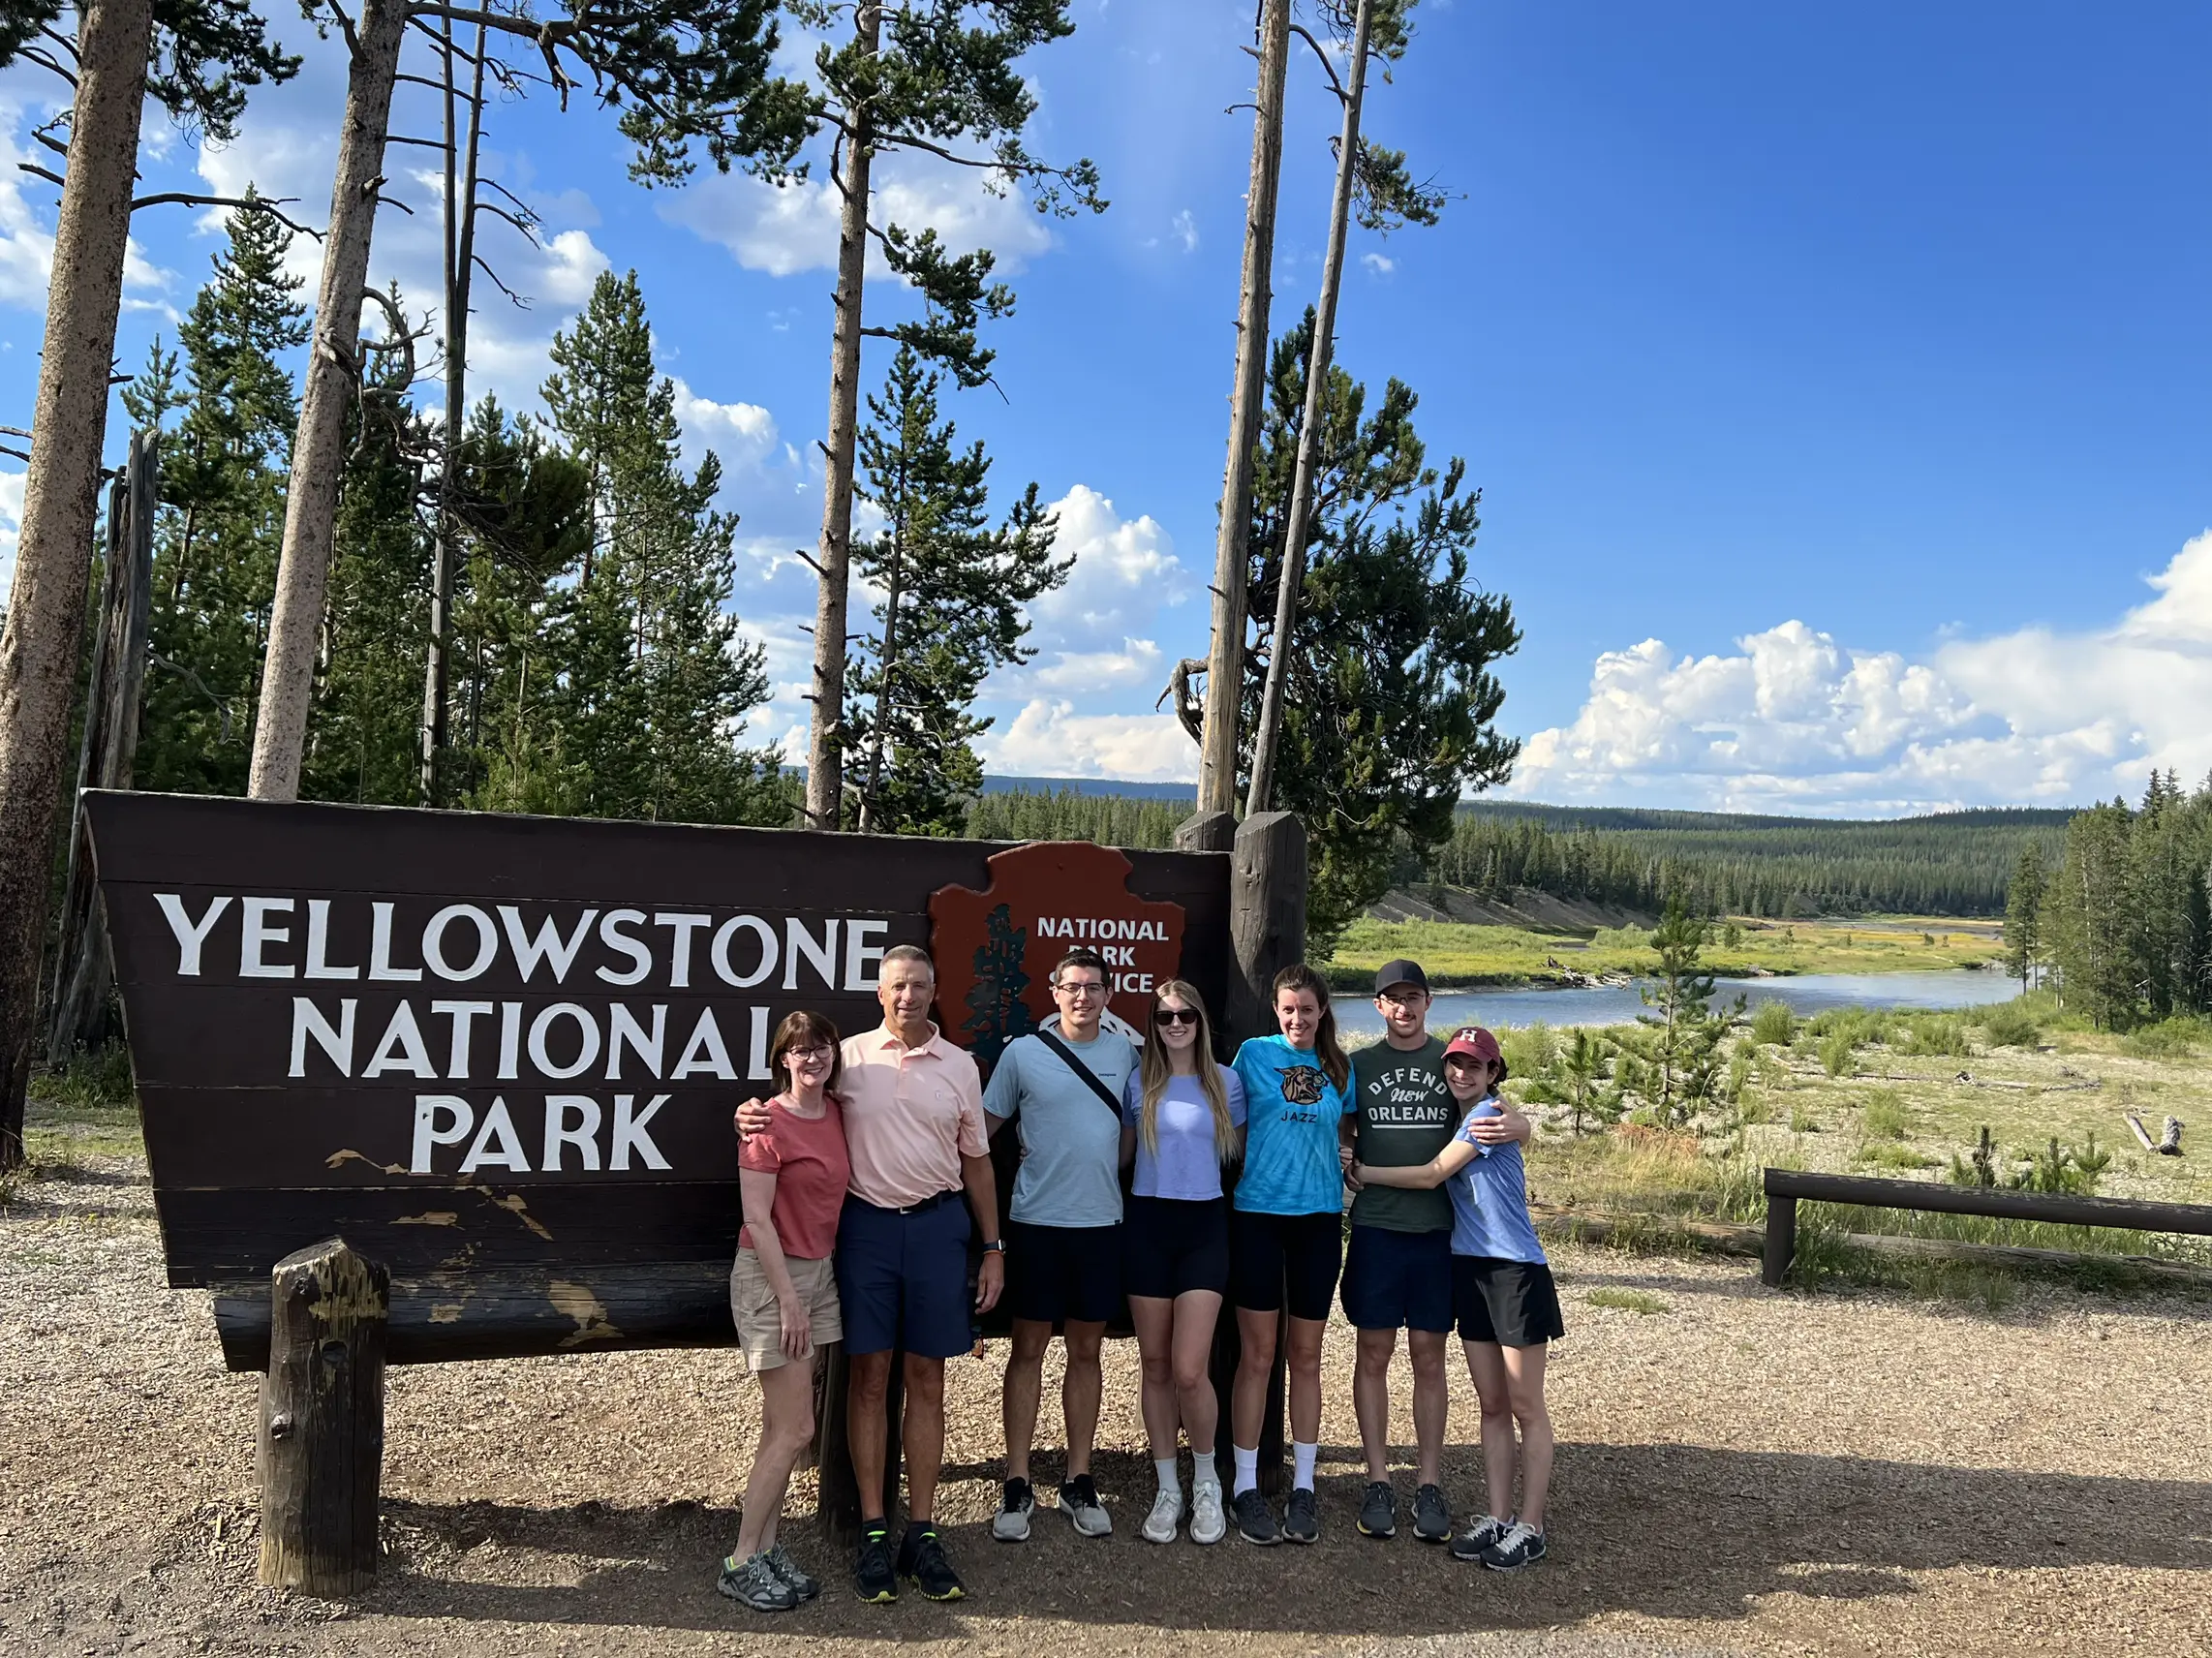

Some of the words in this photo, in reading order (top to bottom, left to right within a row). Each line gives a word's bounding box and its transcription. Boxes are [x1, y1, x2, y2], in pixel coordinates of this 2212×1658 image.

[1037, 916, 1170, 941] NATIONAL
[152, 893, 889, 992] YELLOWSTONE
[287, 997, 774, 1081] NATIONAL
[1459, 1029, 1478, 1043] H
[1367, 1067, 1448, 1095] DEFEND
[1280, 1110, 1318, 1123] JAZZ
[1367, 1106, 1449, 1121] ORLEANS
[411, 1093, 673, 1174] PARK
